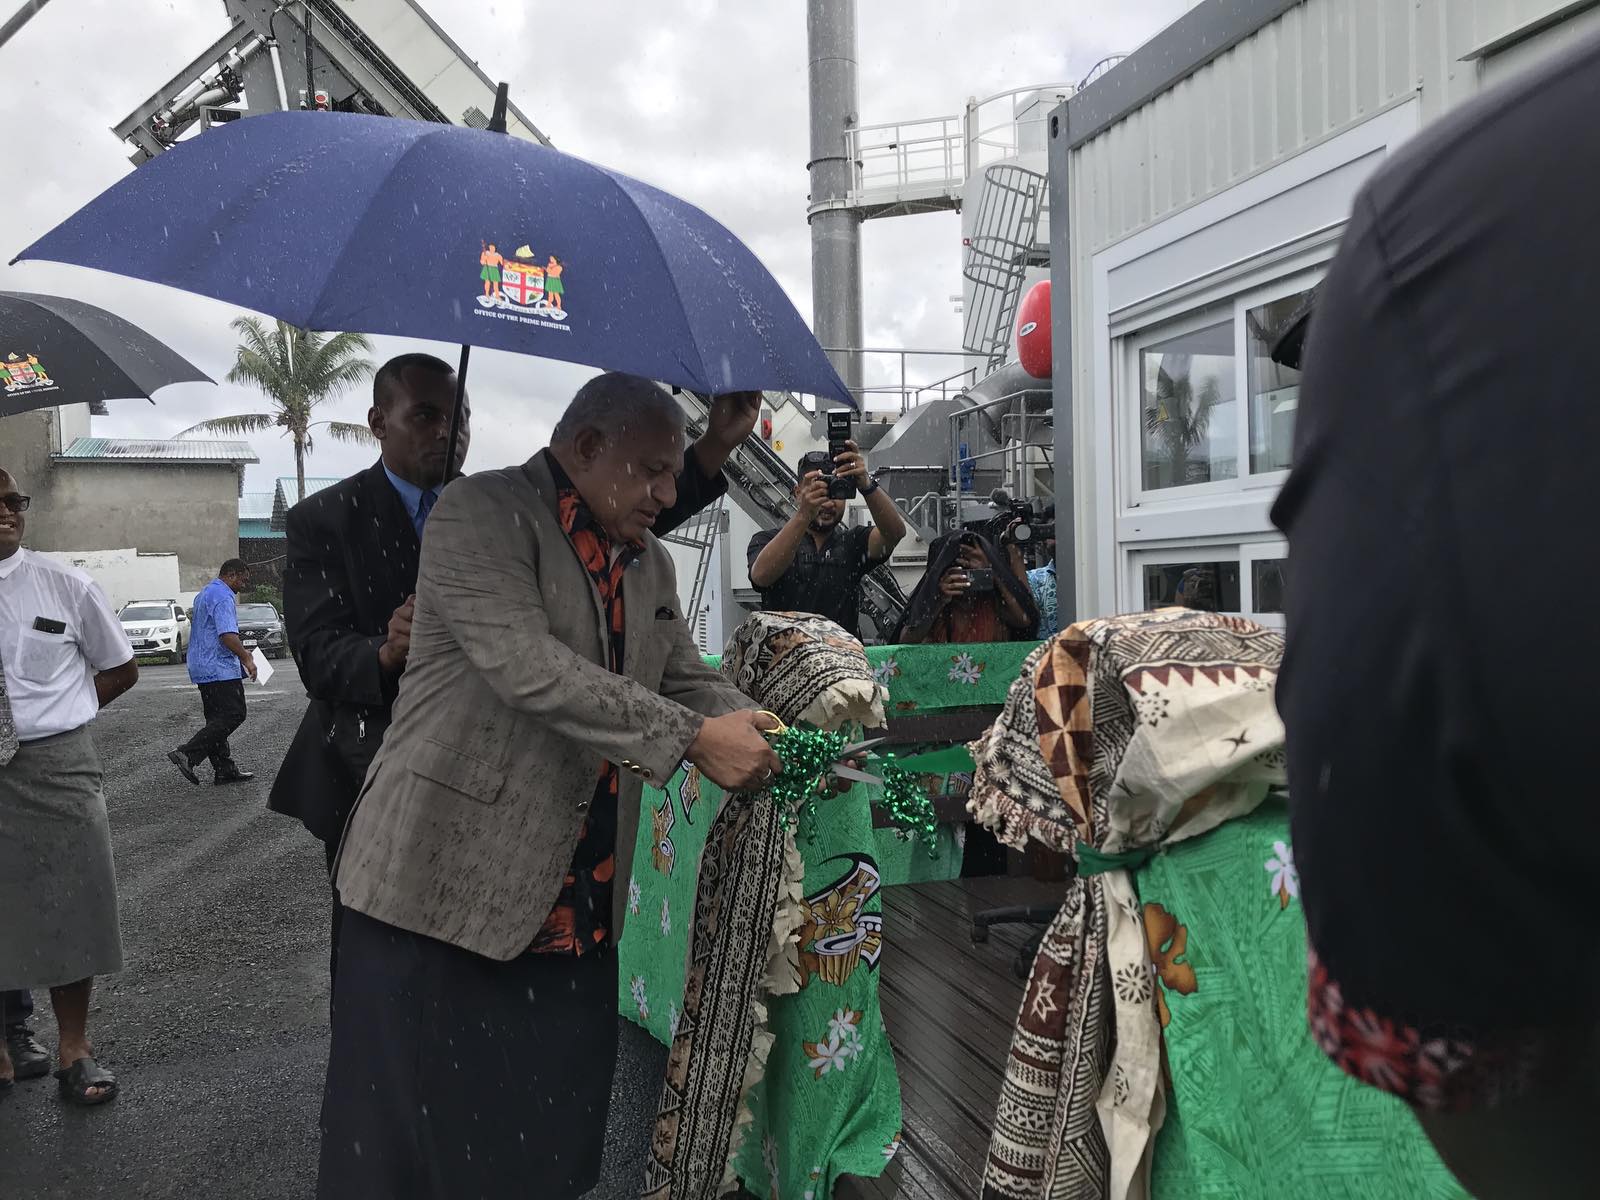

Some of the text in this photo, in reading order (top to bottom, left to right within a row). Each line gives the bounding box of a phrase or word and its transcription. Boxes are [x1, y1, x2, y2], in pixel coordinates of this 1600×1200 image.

[474, 308, 496, 318] OFFICE
[506, 314, 519, 322] THE
[519, 316, 540, 326] PRIME
[541, 320, 570, 331] MINISTER
